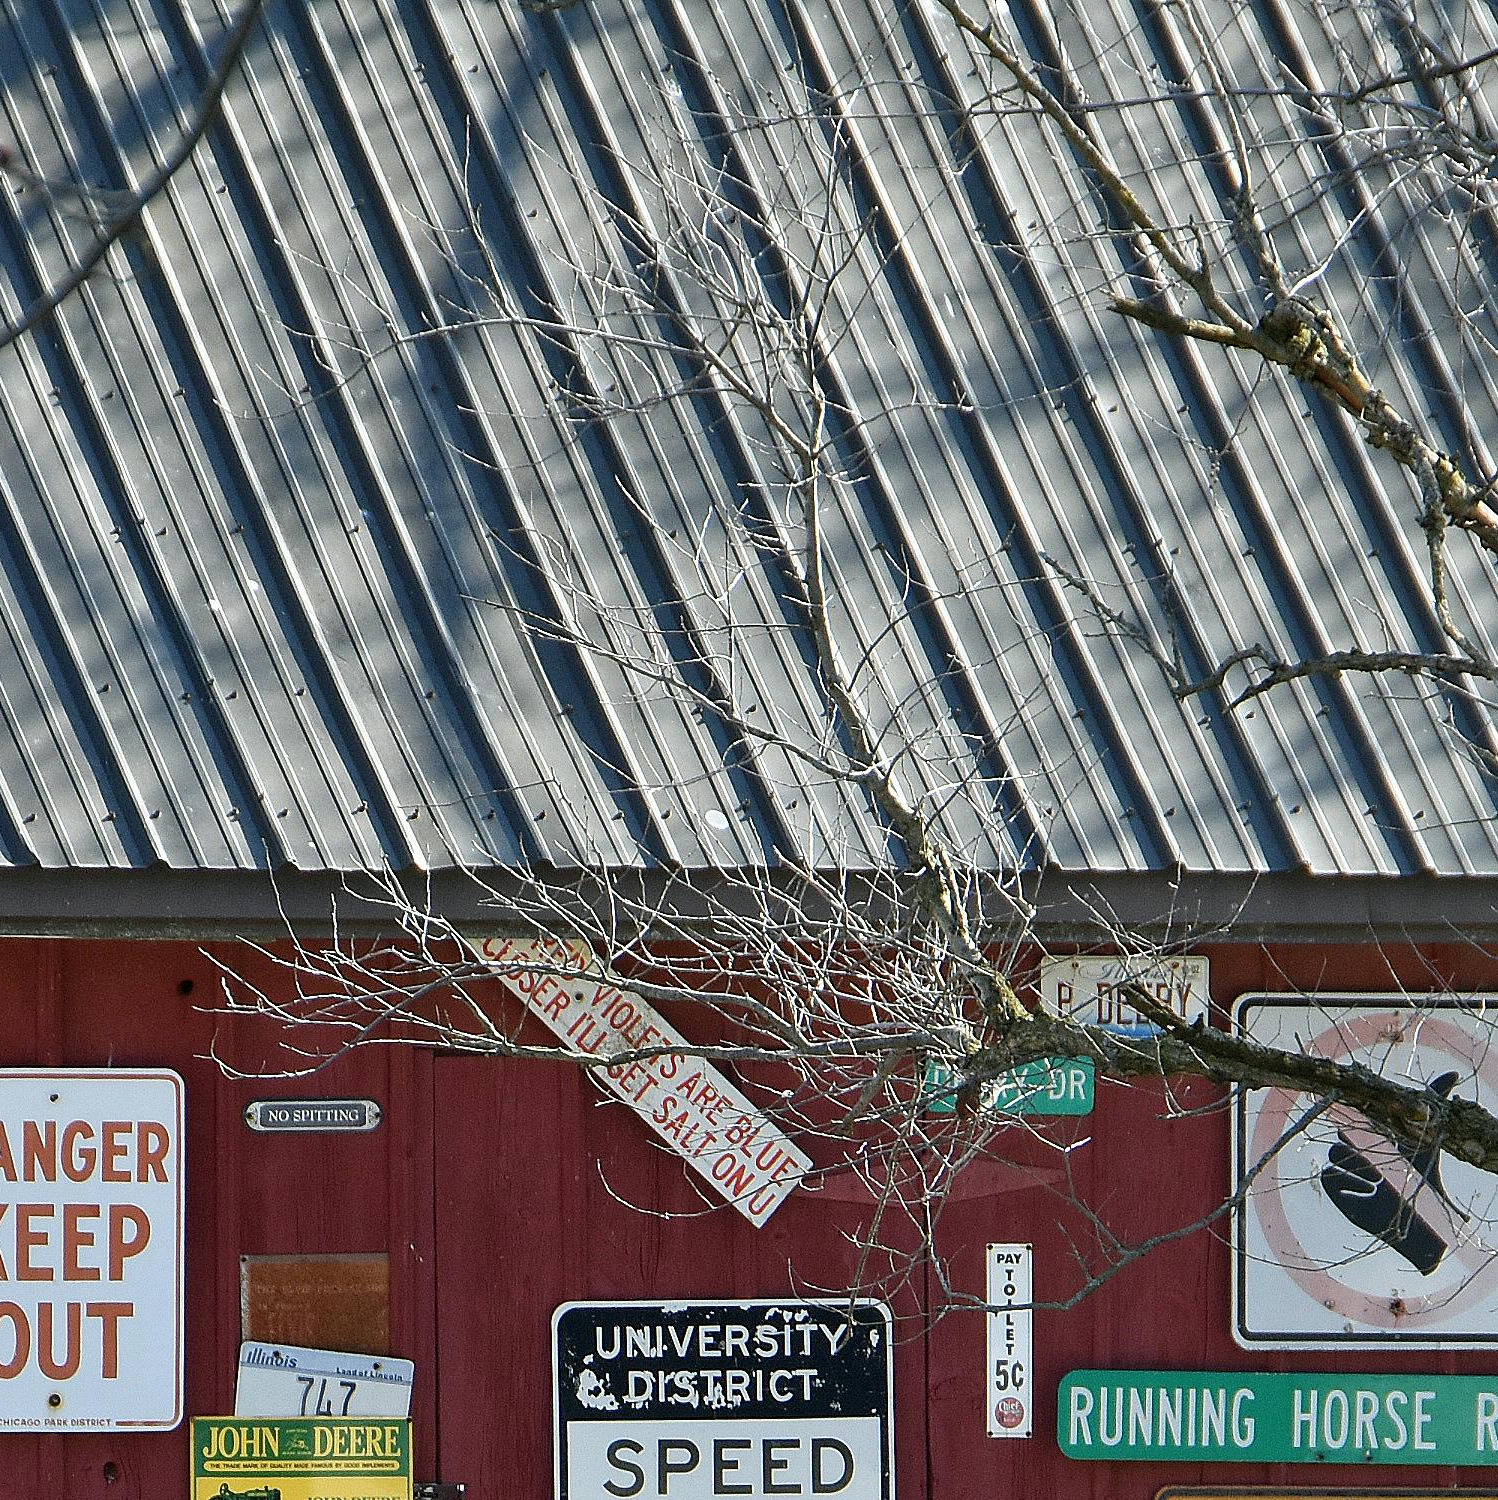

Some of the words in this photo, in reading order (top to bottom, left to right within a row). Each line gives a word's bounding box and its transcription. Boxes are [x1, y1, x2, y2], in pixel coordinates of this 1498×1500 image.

[591, 985, 686, 1079] VIOLETS
[677, 1070, 734, 1126] ARE
[725, 1114, 799, 1188] BLUE
[1049, 1069, 1086, 1100] DR
[268, 1110, 290, 1122] NO
[293, 1109, 359, 1122] SPITTING
[606, 1061, 659, 1103] GET
[653, 1095, 717, 1154] SALT
[711, 1153, 755, 1197] ON
[748, 1193, 775, 1216] U
[996, 1253, 1022, 1264] PAY
[595, 1324, 847, 1360] UNIVERSITY
[246, 1348, 298, 1368] Illinois
[336, 1366, 355, 1376] Land
[370, 1371, 403, 1381] Lincoln
[995, 1360, 1024, 1391] 5¢
[297, 1376, 356, 1416] 747
[626, 1369, 818, 1403] DISTRICT
[44, 1419, 68, 1427] PARK
[70, 1419, 111, 1427] DISTRICT
[1069, 1385, 1256, 1447] RUNNING
[1292, 1389, 1437, 1450] HORSE
[202, 1426, 279, 1458] JOHN
[314, 1426, 401, 1457] DEERE
[602, 1437, 855, 1497] SPEED
